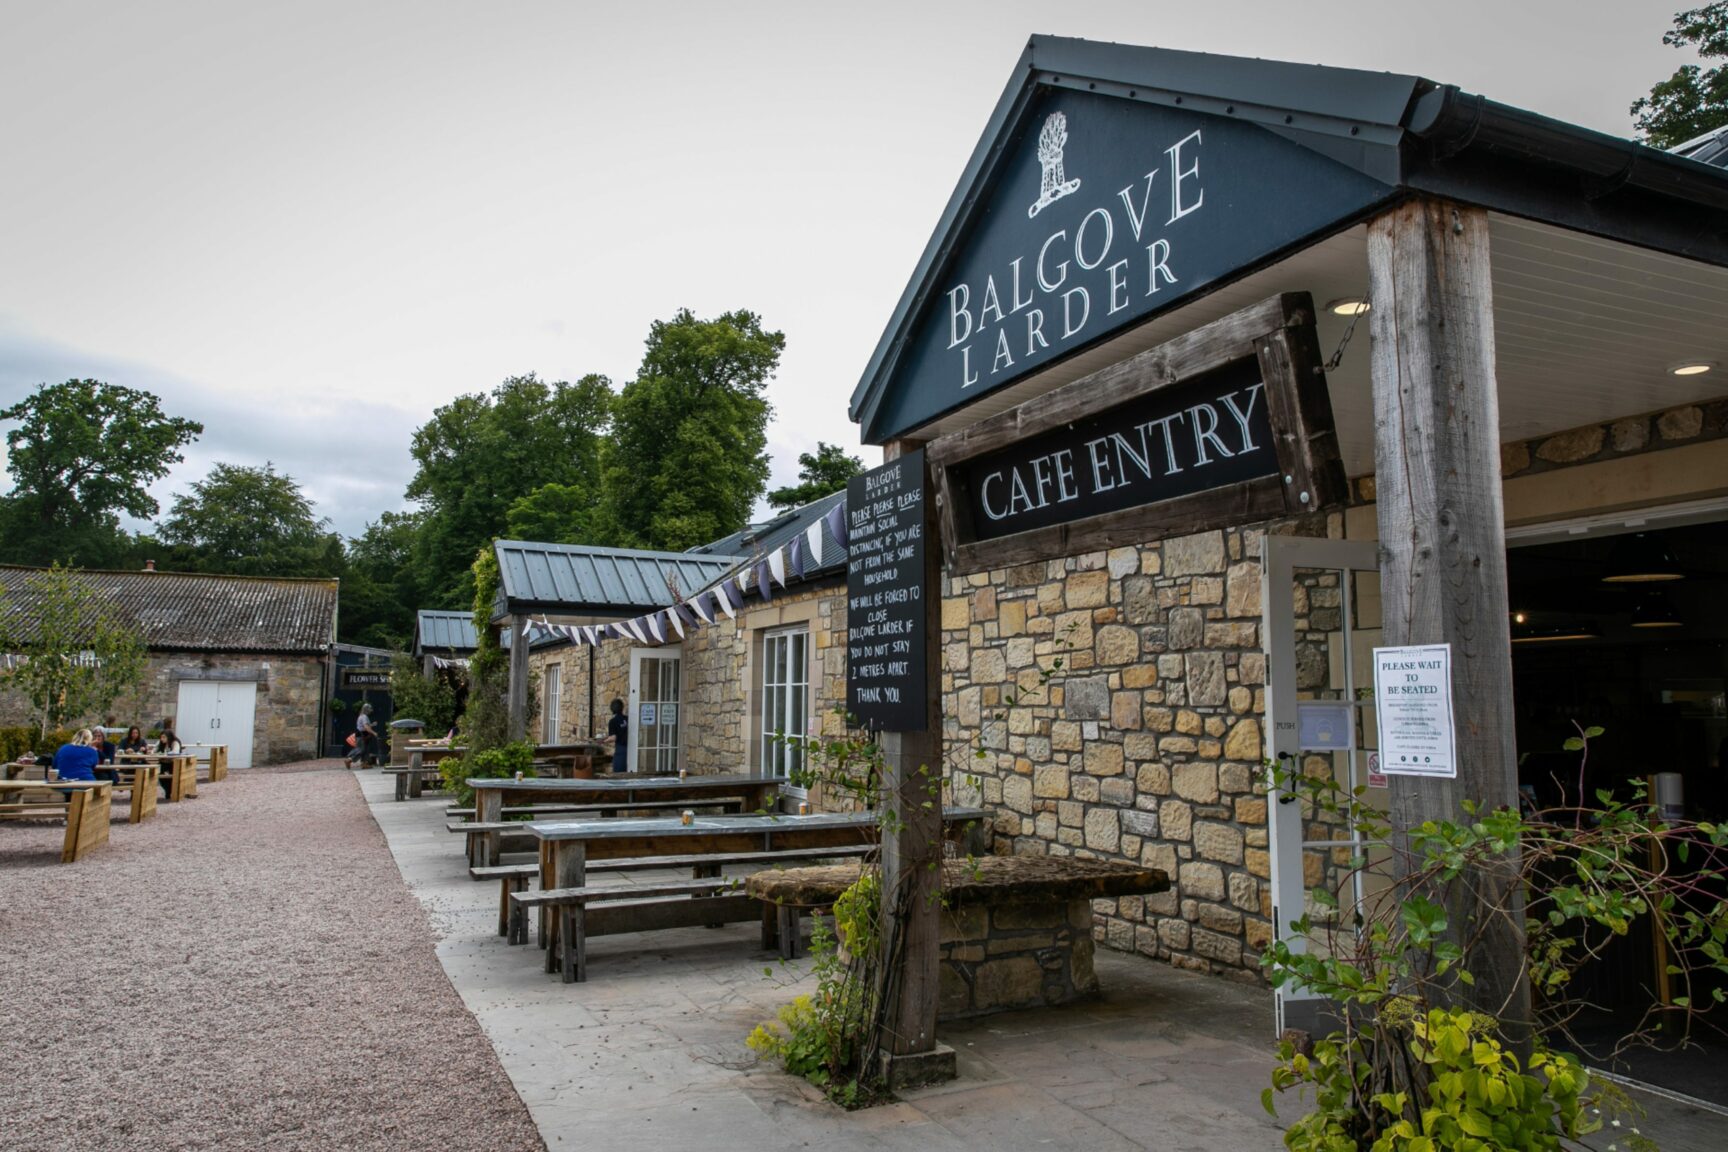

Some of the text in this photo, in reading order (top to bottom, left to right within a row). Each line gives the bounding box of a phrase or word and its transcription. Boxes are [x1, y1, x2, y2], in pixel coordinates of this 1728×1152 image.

[947, 129, 1204, 350] BALGOVE
[961, 238, 1178, 389] LARDER
[981, 383, 1264, 521] CAFE ENTRY
[866, 465, 901, 491] BALGOVE
[866, 481, 900, 500] LARDER
[851, 489, 921, 525] PLEASE PLEASE PLEASE
[850, 516, 898, 540] MAINTAIN SOCIAL
[850, 524, 921, 556] DISTANCING IF YOU ARE
[850, 545, 914, 574] NOT FROM THE SAME
[850, 585, 920, 610] WE WILL BE FORCED TO
[868, 609, 887, 623] CLOSE
[849, 620, 913, 641] BALGOVE LARDER IF
[850, 640, 910, 659] YOU DO NOT STAY
[852, 667, 857, 680] 2
[860, 663, 885, 677] METRES
[1382, 661, 1442, 671] PLEASE WAIT
[1405, 674, 1418, 682] TO
[857, 687, 881, 703] THANK
[1388, 686, 1437, 694] BE SEATED
[1276, 722, 1295, 730] PUSH
